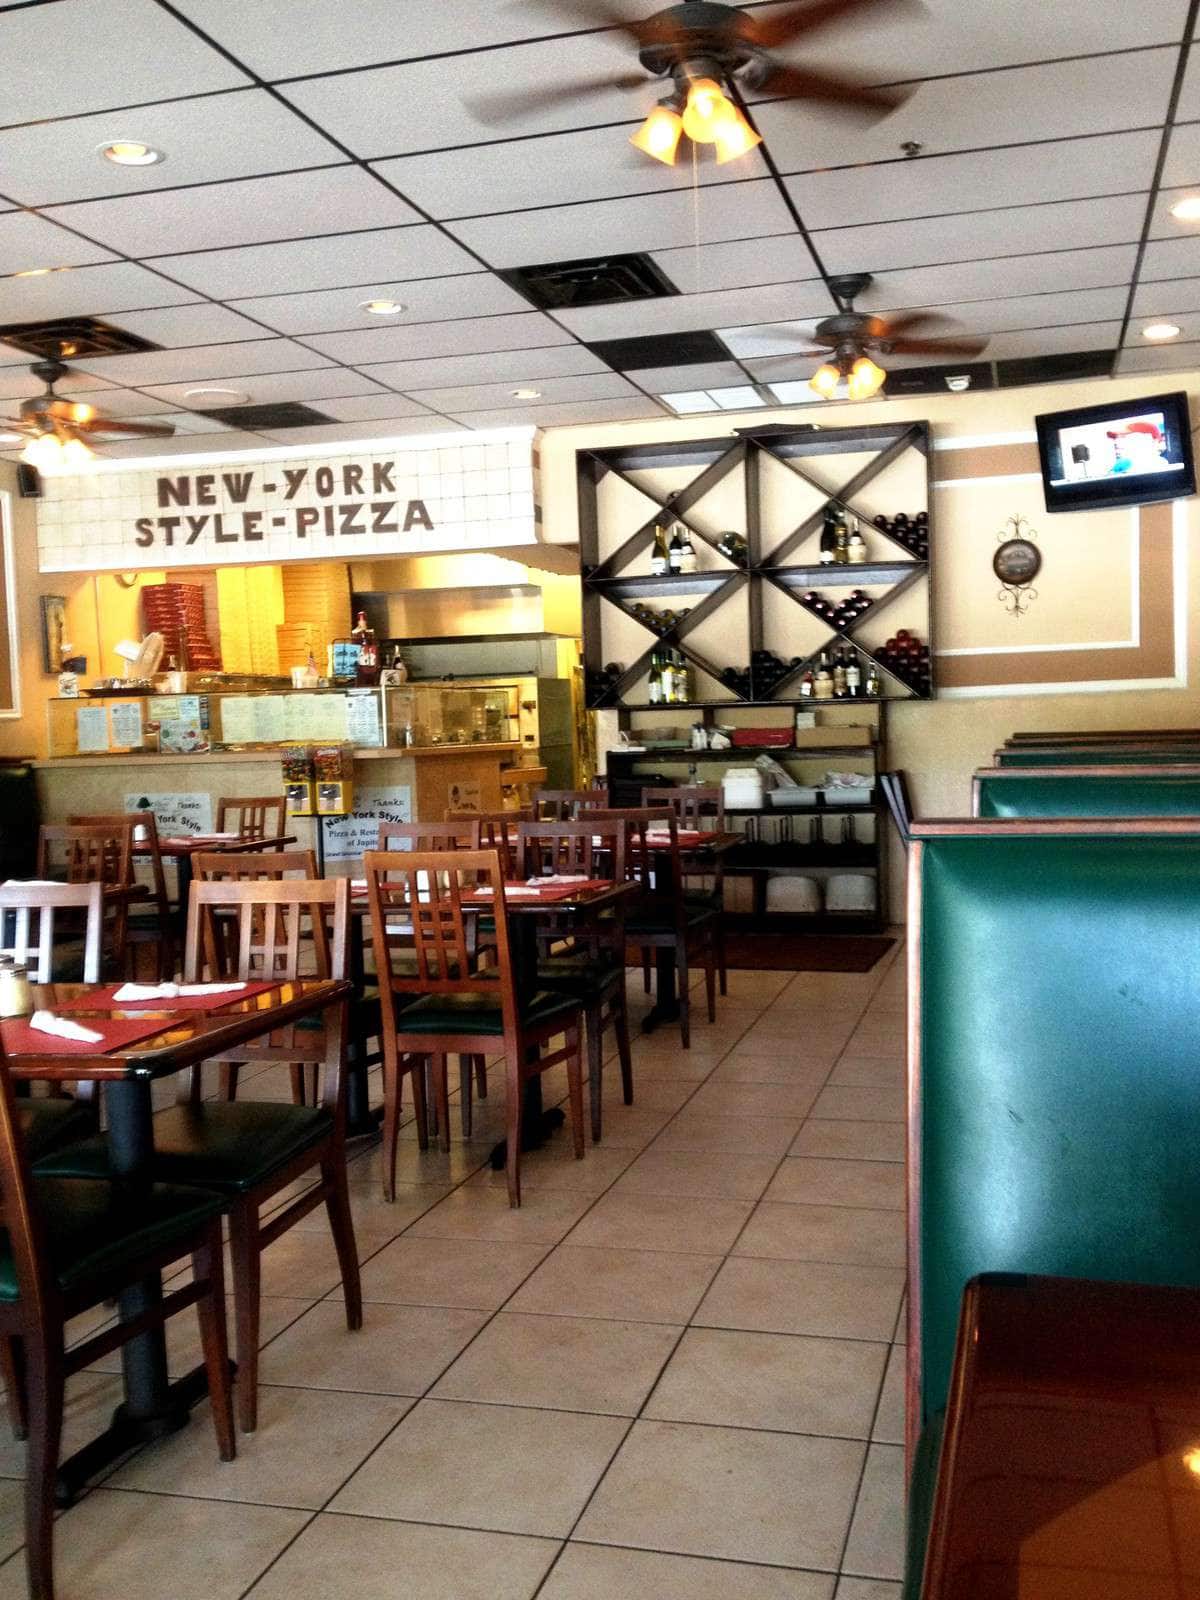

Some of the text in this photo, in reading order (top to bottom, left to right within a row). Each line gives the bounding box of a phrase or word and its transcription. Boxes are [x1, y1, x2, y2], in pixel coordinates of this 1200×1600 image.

[156, 461, 397, 508] NEW-YORK
[134, 499, 435, 548] STYLE-PIZZA
[157, 814, 178, 824] York
[352, 810, 375, 819] York
